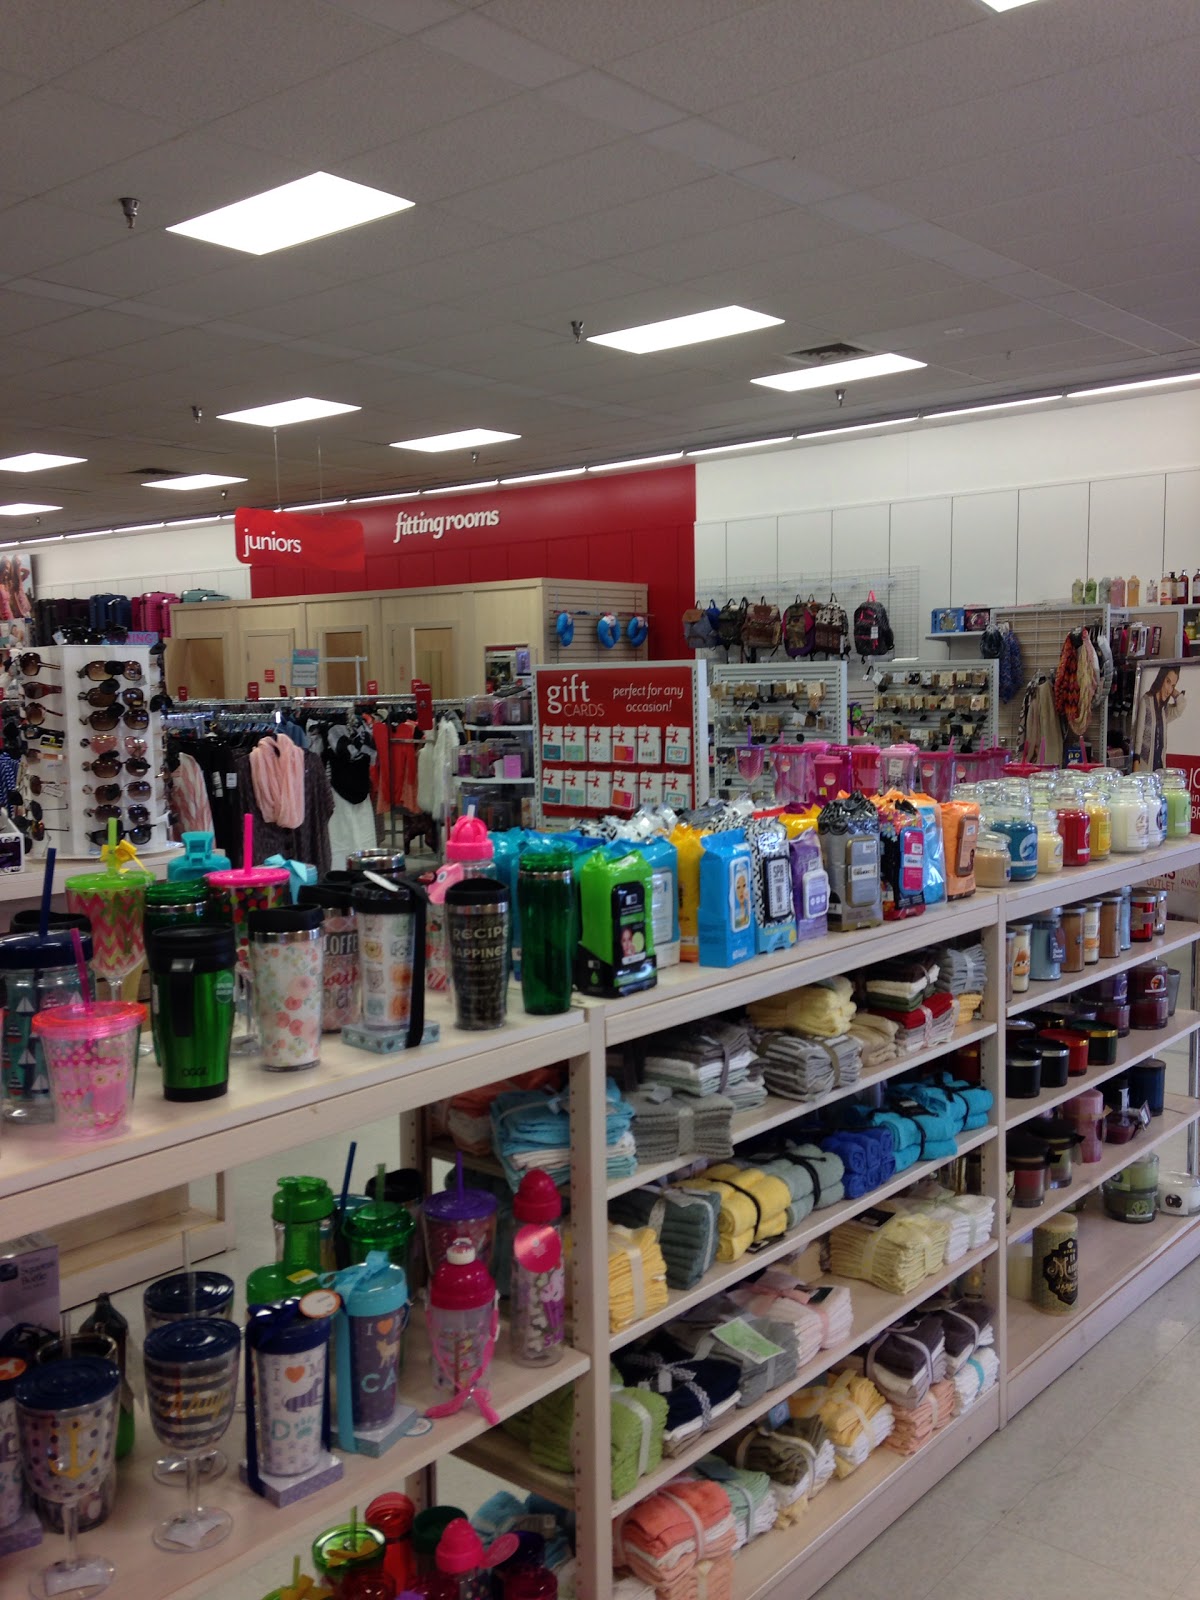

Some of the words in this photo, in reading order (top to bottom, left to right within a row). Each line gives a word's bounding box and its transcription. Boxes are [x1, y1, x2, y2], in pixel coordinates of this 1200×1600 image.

[243, 528, 302, 558] juniors
[547, 673, 590, 714] gift
[613, 683, 646, 700] perfect
[646, 682, 662, 700] for
[663, 686, 684, 699] any
[563, 703, 605, 718] CARDS
[625, 699, 673, 713] occasion!
